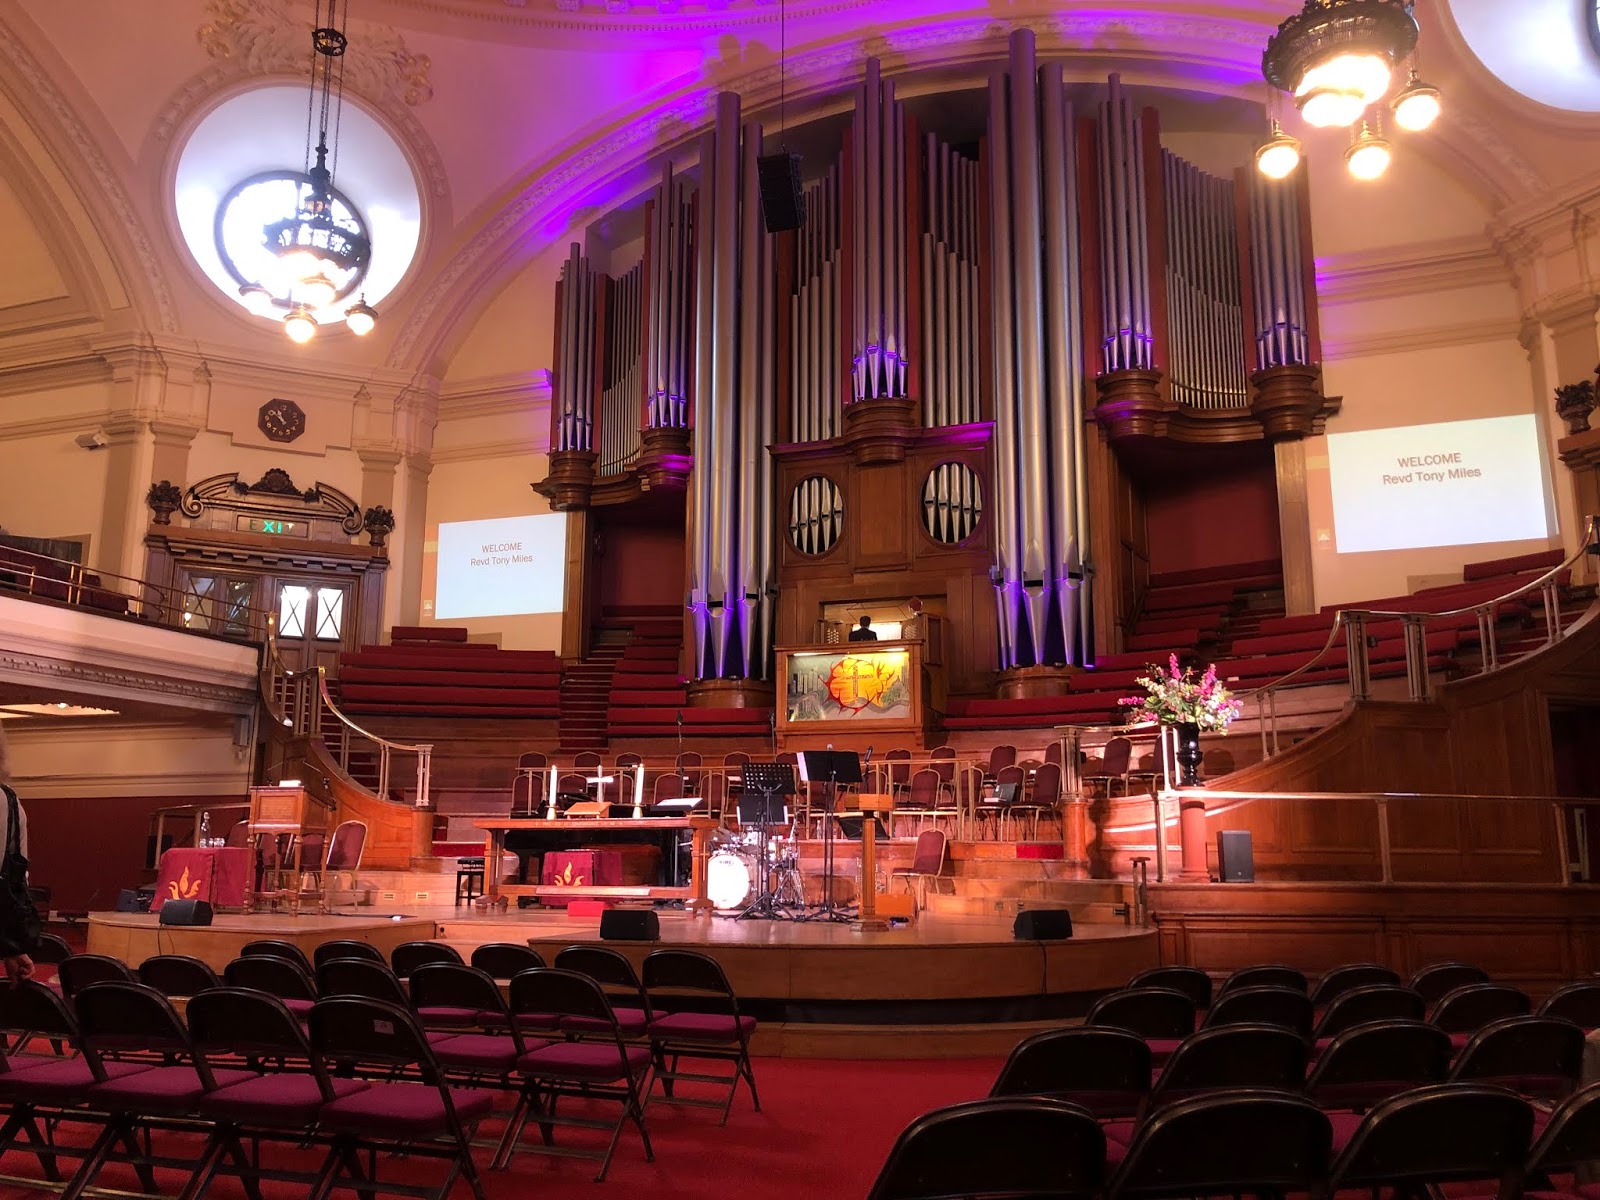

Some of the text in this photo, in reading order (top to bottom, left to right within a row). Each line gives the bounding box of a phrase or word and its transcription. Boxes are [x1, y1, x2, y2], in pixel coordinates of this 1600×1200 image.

[1397, 452, 1462, 468] WELCOME
[1382, 468, 1482, 485] Revd Tony Miles
[249, 519, 295, 536] EXIT
[481, 542, 522, 553] WELCOME
[470, 554, 533, 566] Revd Tony Miles
